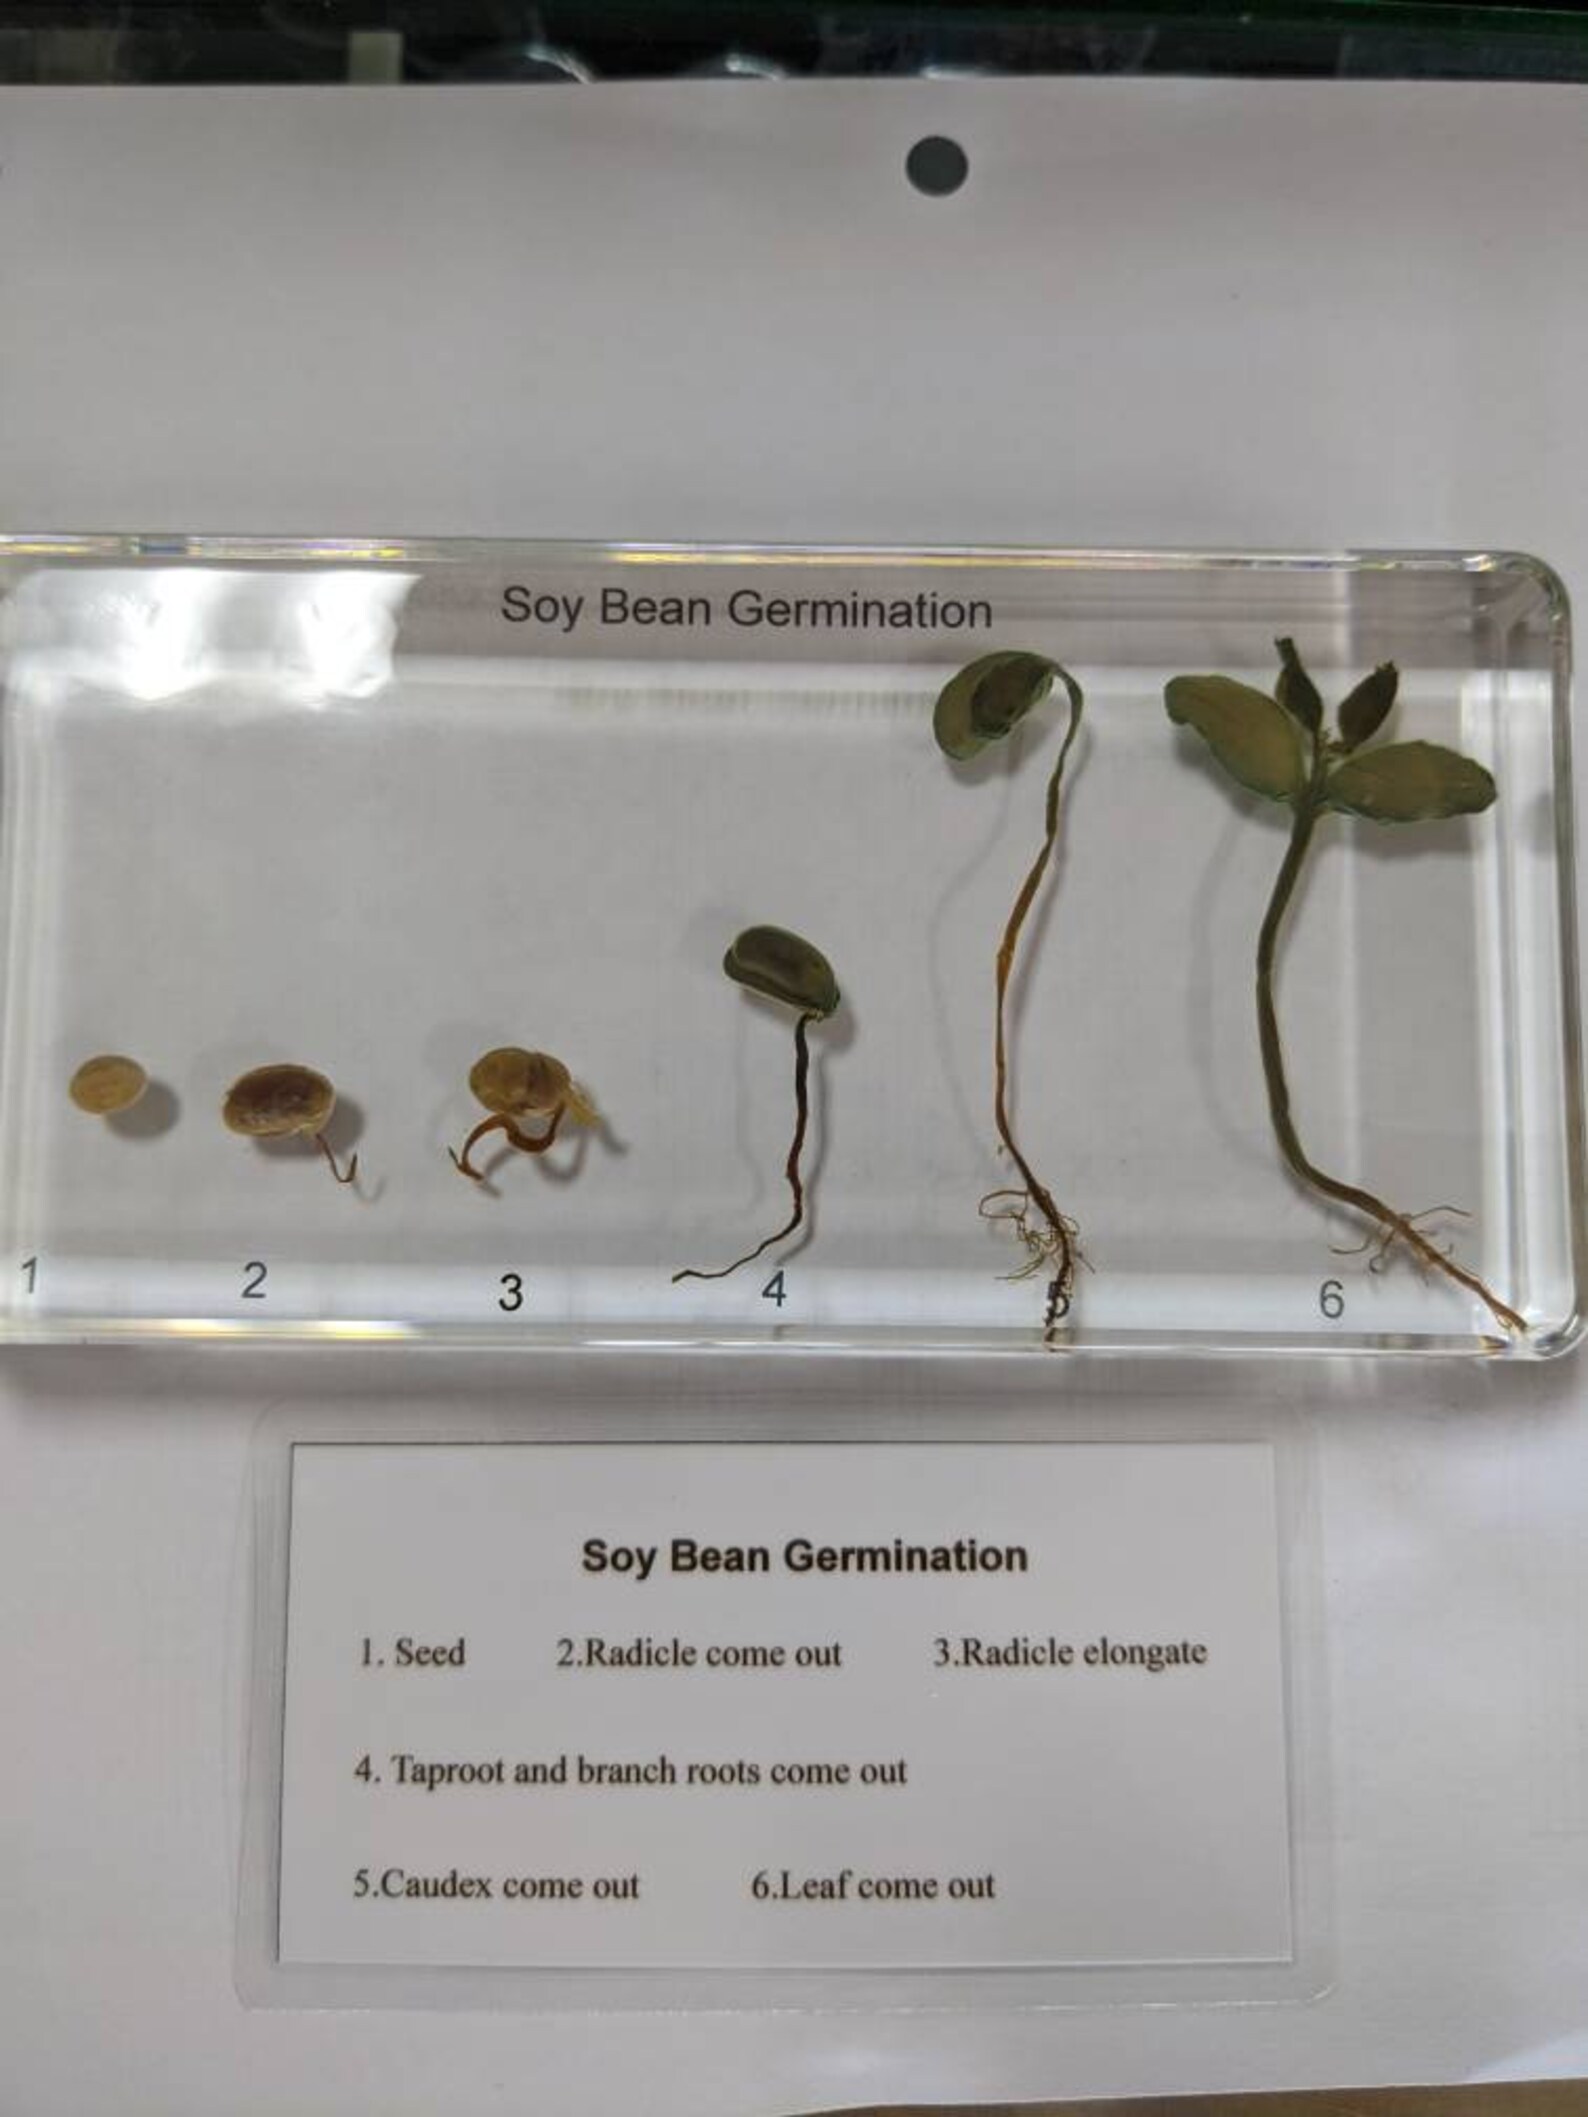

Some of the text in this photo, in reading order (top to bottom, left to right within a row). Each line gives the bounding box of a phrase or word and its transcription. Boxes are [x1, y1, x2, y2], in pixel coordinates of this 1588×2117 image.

[501, 585, 993, 633] Soy Bean Germination
[21, 1256, 37, 1293] 1
[241, 1260, 268, 1299] 2
[498, 1272, 524, 1312] 3
[761, 1269, 787, 1308] 4
[1320, 1279, 1345, 1319] 6
[581, 1537, 1029, 1583] Soy Bean Germination
[361, 1636, 466, 1668] 1. Seed
[556, 1636, 843, 1668] 2.Radicle come out
[933, 1636, 1208, 1674] 3.Radicle elongate
[353, 1754, 908, 1793] 4. Taproot and branch roots come out
[353, 1868, 640, 1900] 5.Caudex come out
[751, 1869, 996, 1901] 6.Leaf come out
